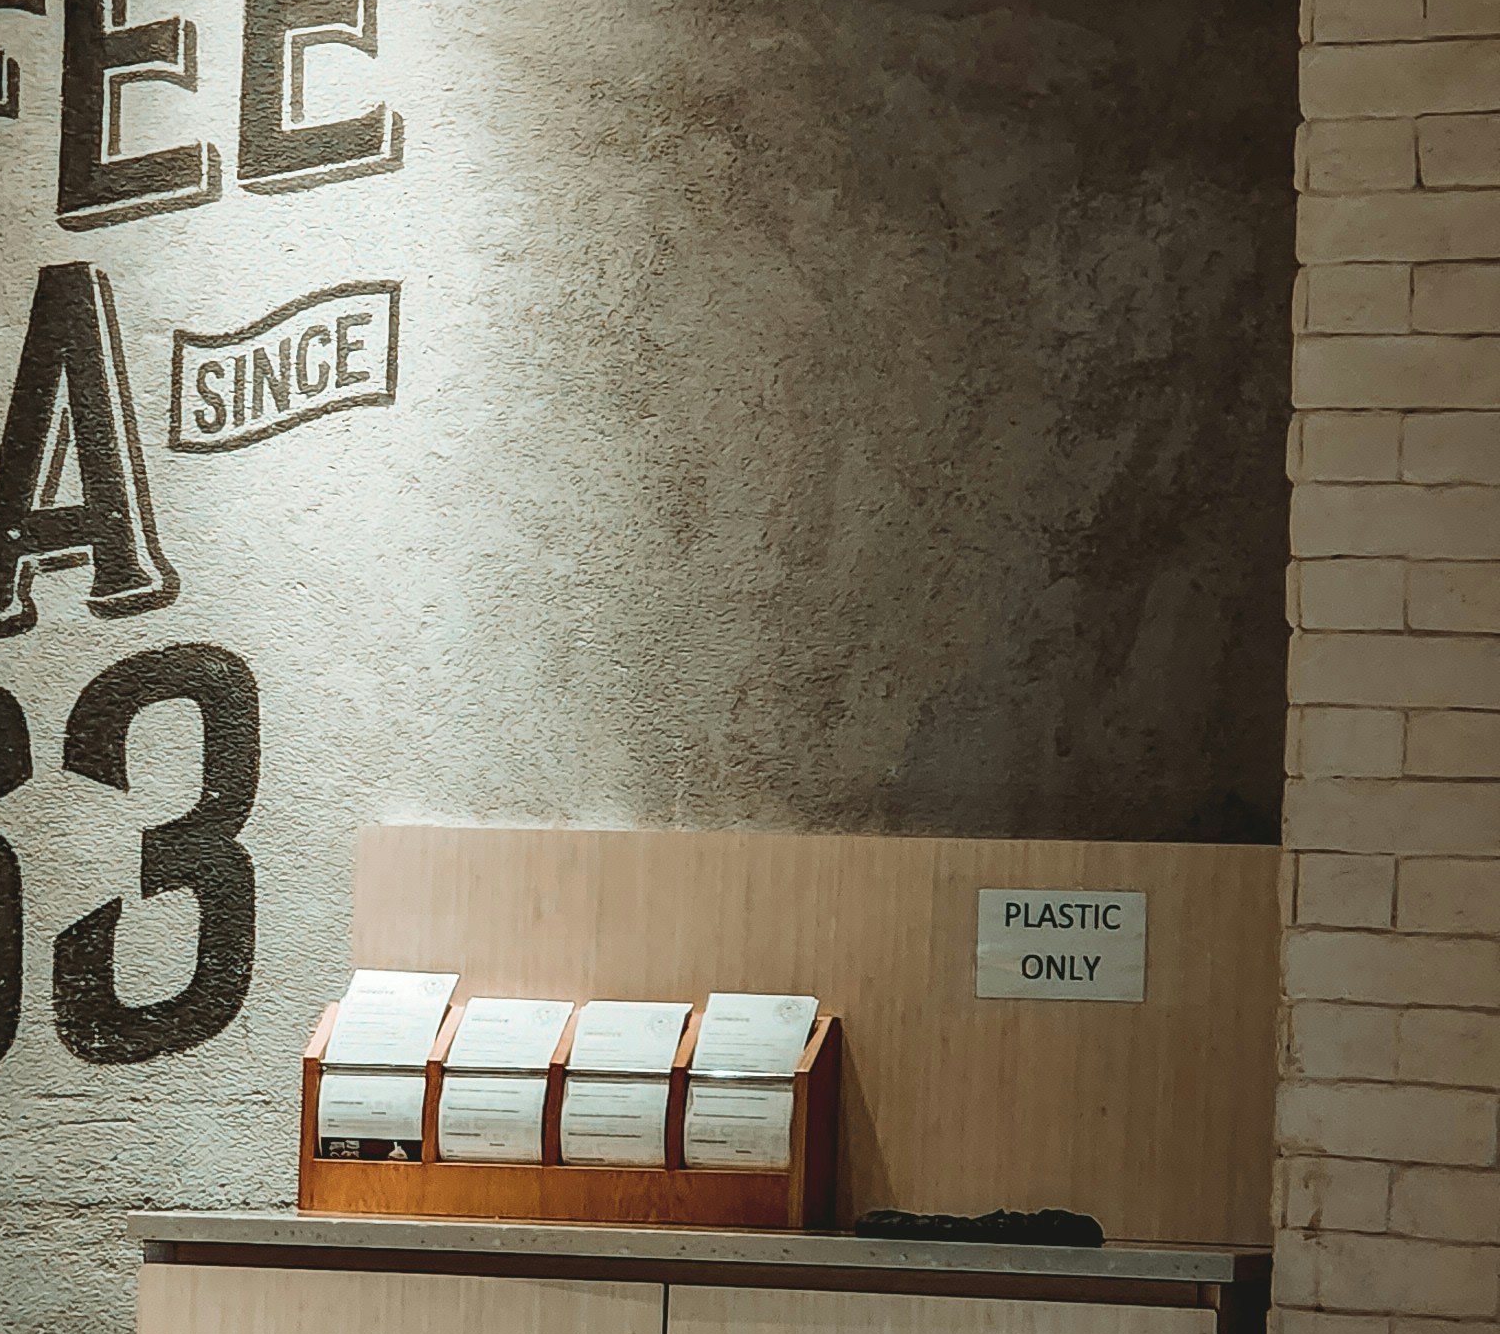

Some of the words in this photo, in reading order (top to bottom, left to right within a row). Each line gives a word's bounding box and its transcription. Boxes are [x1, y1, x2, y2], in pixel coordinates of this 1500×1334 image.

[193, 311, 370, 434] SINCE
[1004, 901, 1122, 930] PLASTIC
[1021, 953, 1102, 982] ONLY
